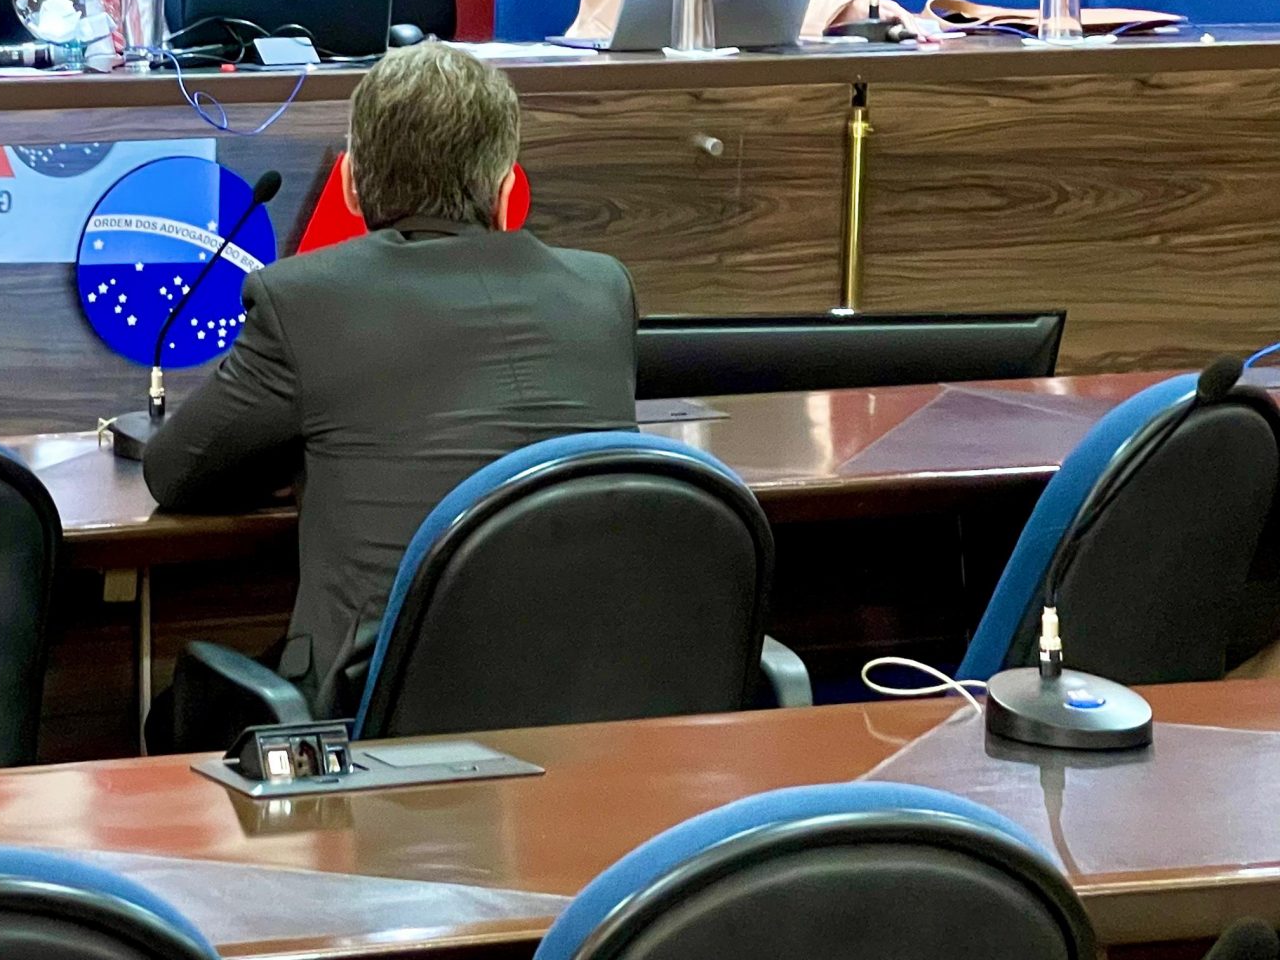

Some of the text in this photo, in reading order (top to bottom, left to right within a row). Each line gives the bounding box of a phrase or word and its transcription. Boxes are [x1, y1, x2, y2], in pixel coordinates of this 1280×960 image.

[93, 218, 132, 228] ORDEM
[135, 219, 158, 231] DOS
[225, 245, 240, 259] DO
